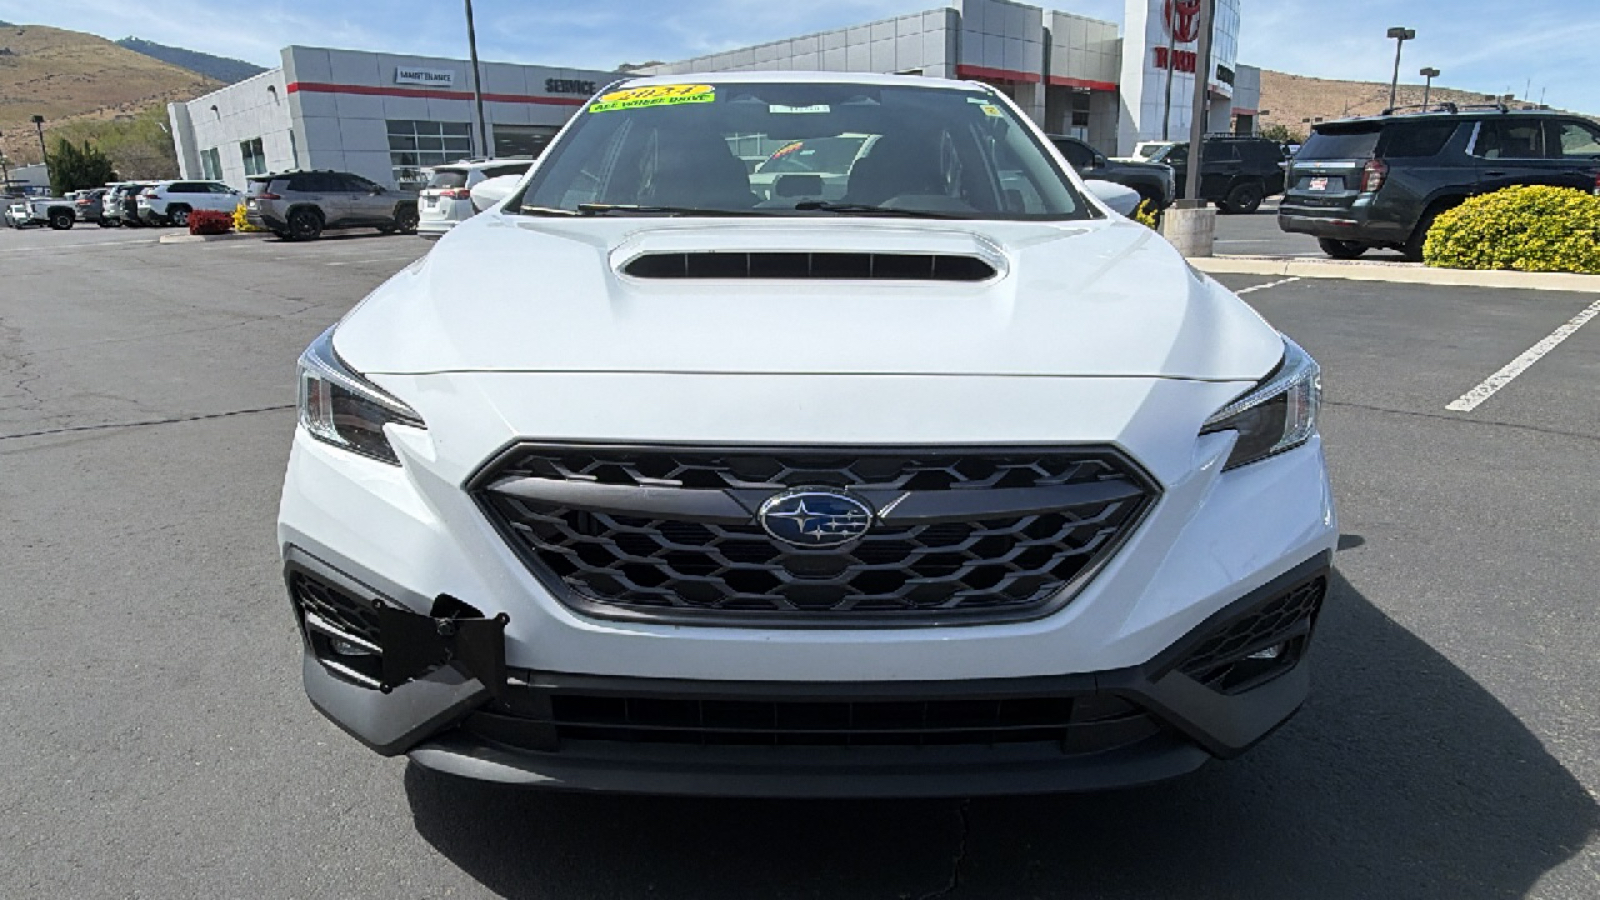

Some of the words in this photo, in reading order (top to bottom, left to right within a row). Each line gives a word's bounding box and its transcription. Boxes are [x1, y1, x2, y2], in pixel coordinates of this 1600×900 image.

[400, 71, 451, 81] MAINTENANCE
[545, 78, 596, 96] SERVICE
[622, 98, 666, 108] WHEEL
[669, 94, 711, 103] DRIVE
